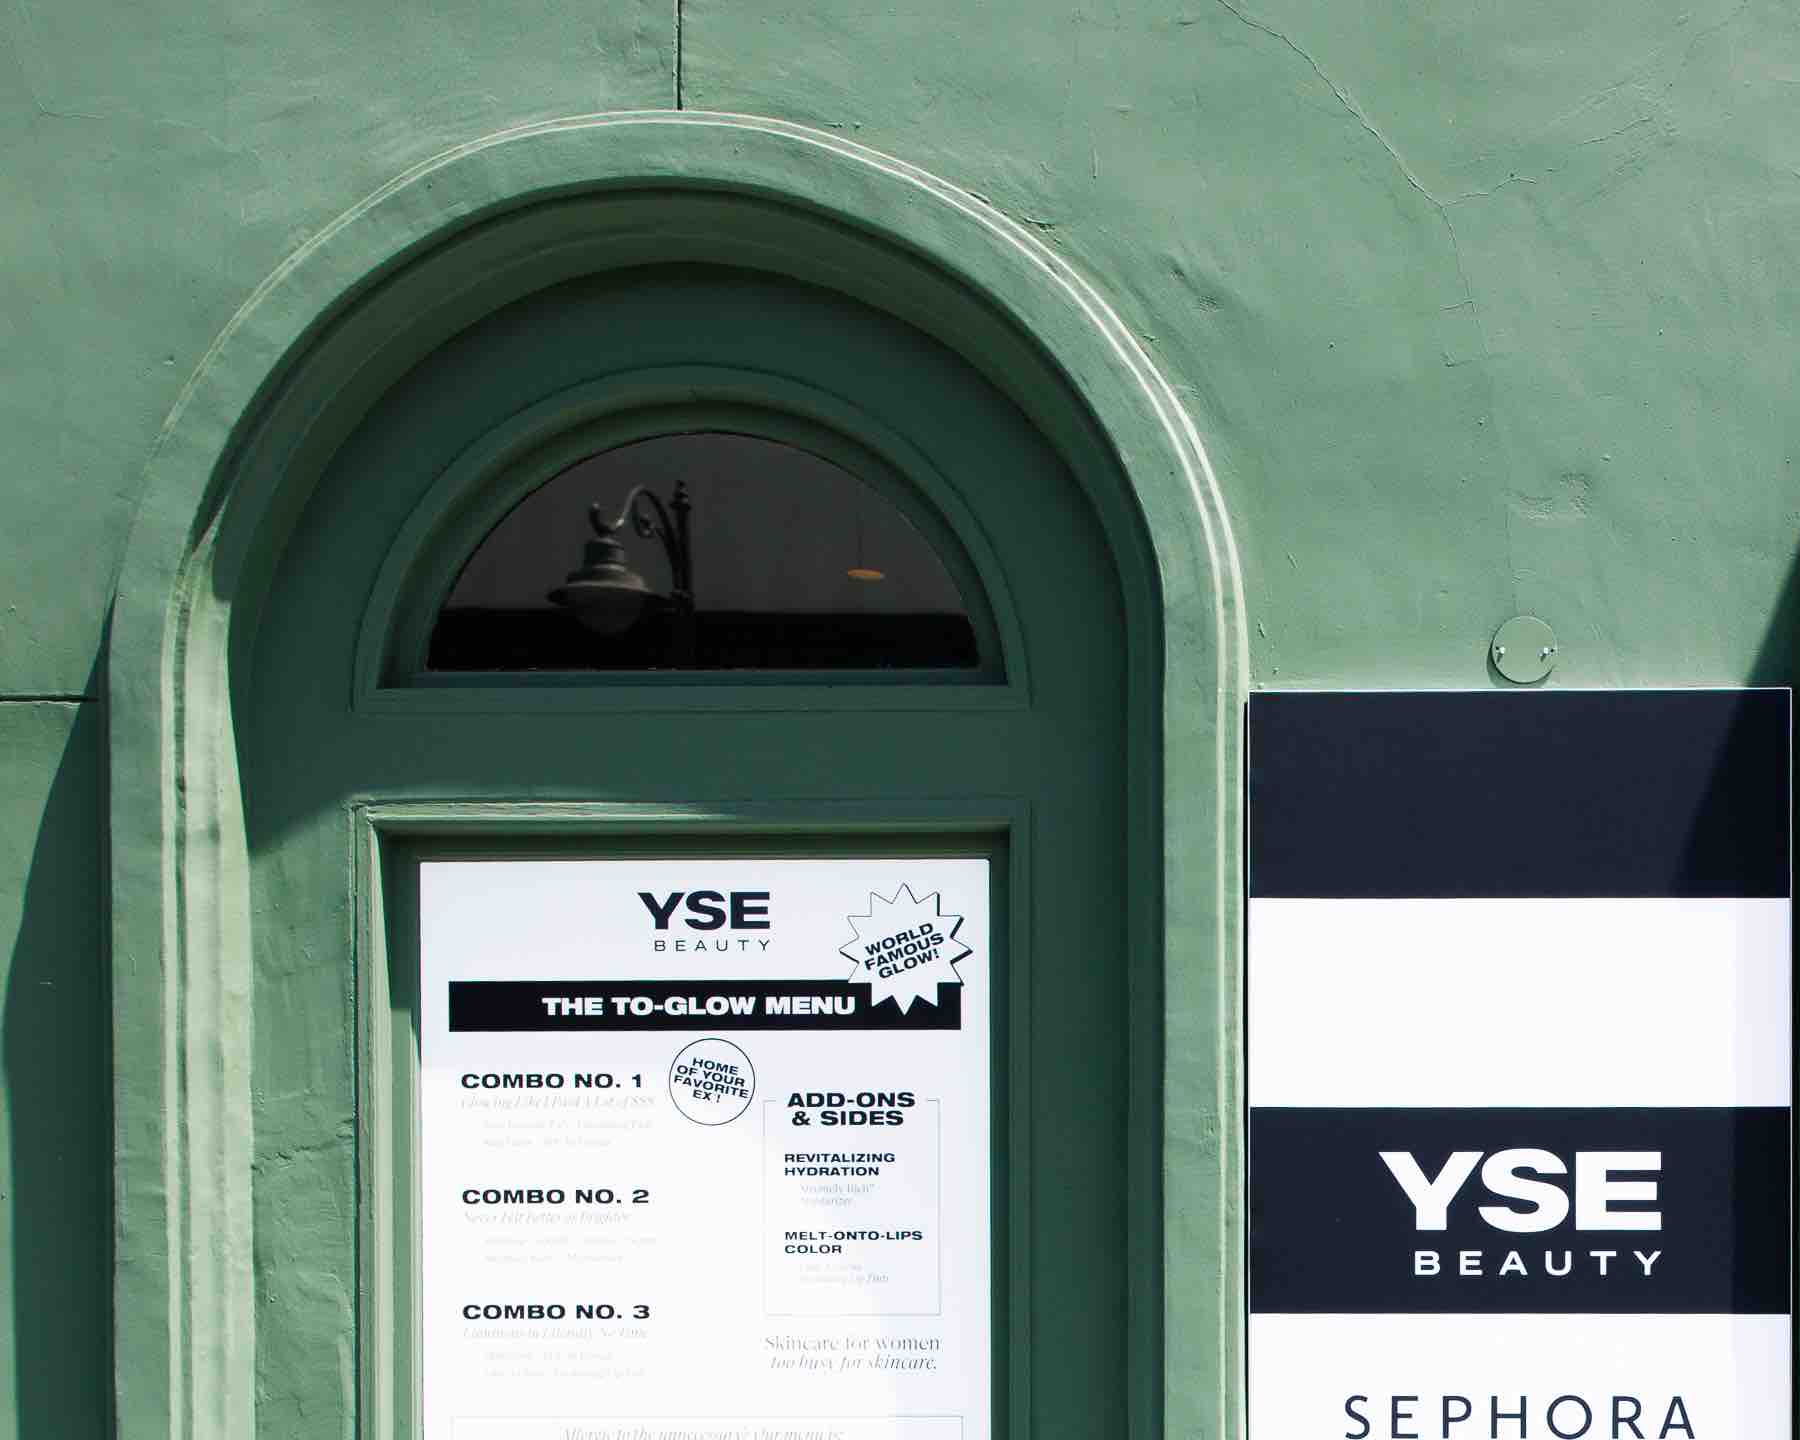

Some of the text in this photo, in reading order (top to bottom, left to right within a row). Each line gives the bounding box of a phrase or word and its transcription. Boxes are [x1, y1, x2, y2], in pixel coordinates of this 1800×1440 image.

[638, 891, 770, 930] YSE
[655, 940, 769, 951] BEAUTY
[865, 922, 934, 956] WORLD
[864, 932, 945, 971] FAMOUS
[878, 948, 940, 979] GLOW!
[542, 997, 855, 1015] THE TO-GLOW MENU
[691, 1057, 740, 1076] HOME
[462, 1074, 642, 1088] COMBO NO. 1
[676, 1065, 746, 1088] OF YOUR
[673, 1075, 750, 1099] FAVORITE
[788, 1092, 915, 1107] ADD-ONS
[792, 1111, 903, 1126] & SIDES
[785, 1153, 895, 1162] REVITALIZING
[785, 1167, 879, 1176] HYDRATION
[463, 1189, 648, 1204] COMBO NO. 2
[1379, 1149, 1661, 1232] YSE
[785, 1231, 922, 1240] MELT-ONTO-LIPS
[785, 1245, 841, 1254] COLOR
[1415, 1251, 1661, 1275] BEAUTY
[463, 1305, 649, 1319] COMBO NO. 3
[765, 1336, 940, 1351] Skincare for women
[867, 1354, 938, 1370] skincare.
[1345, 1395, 1694, 1439] SEPHORA
